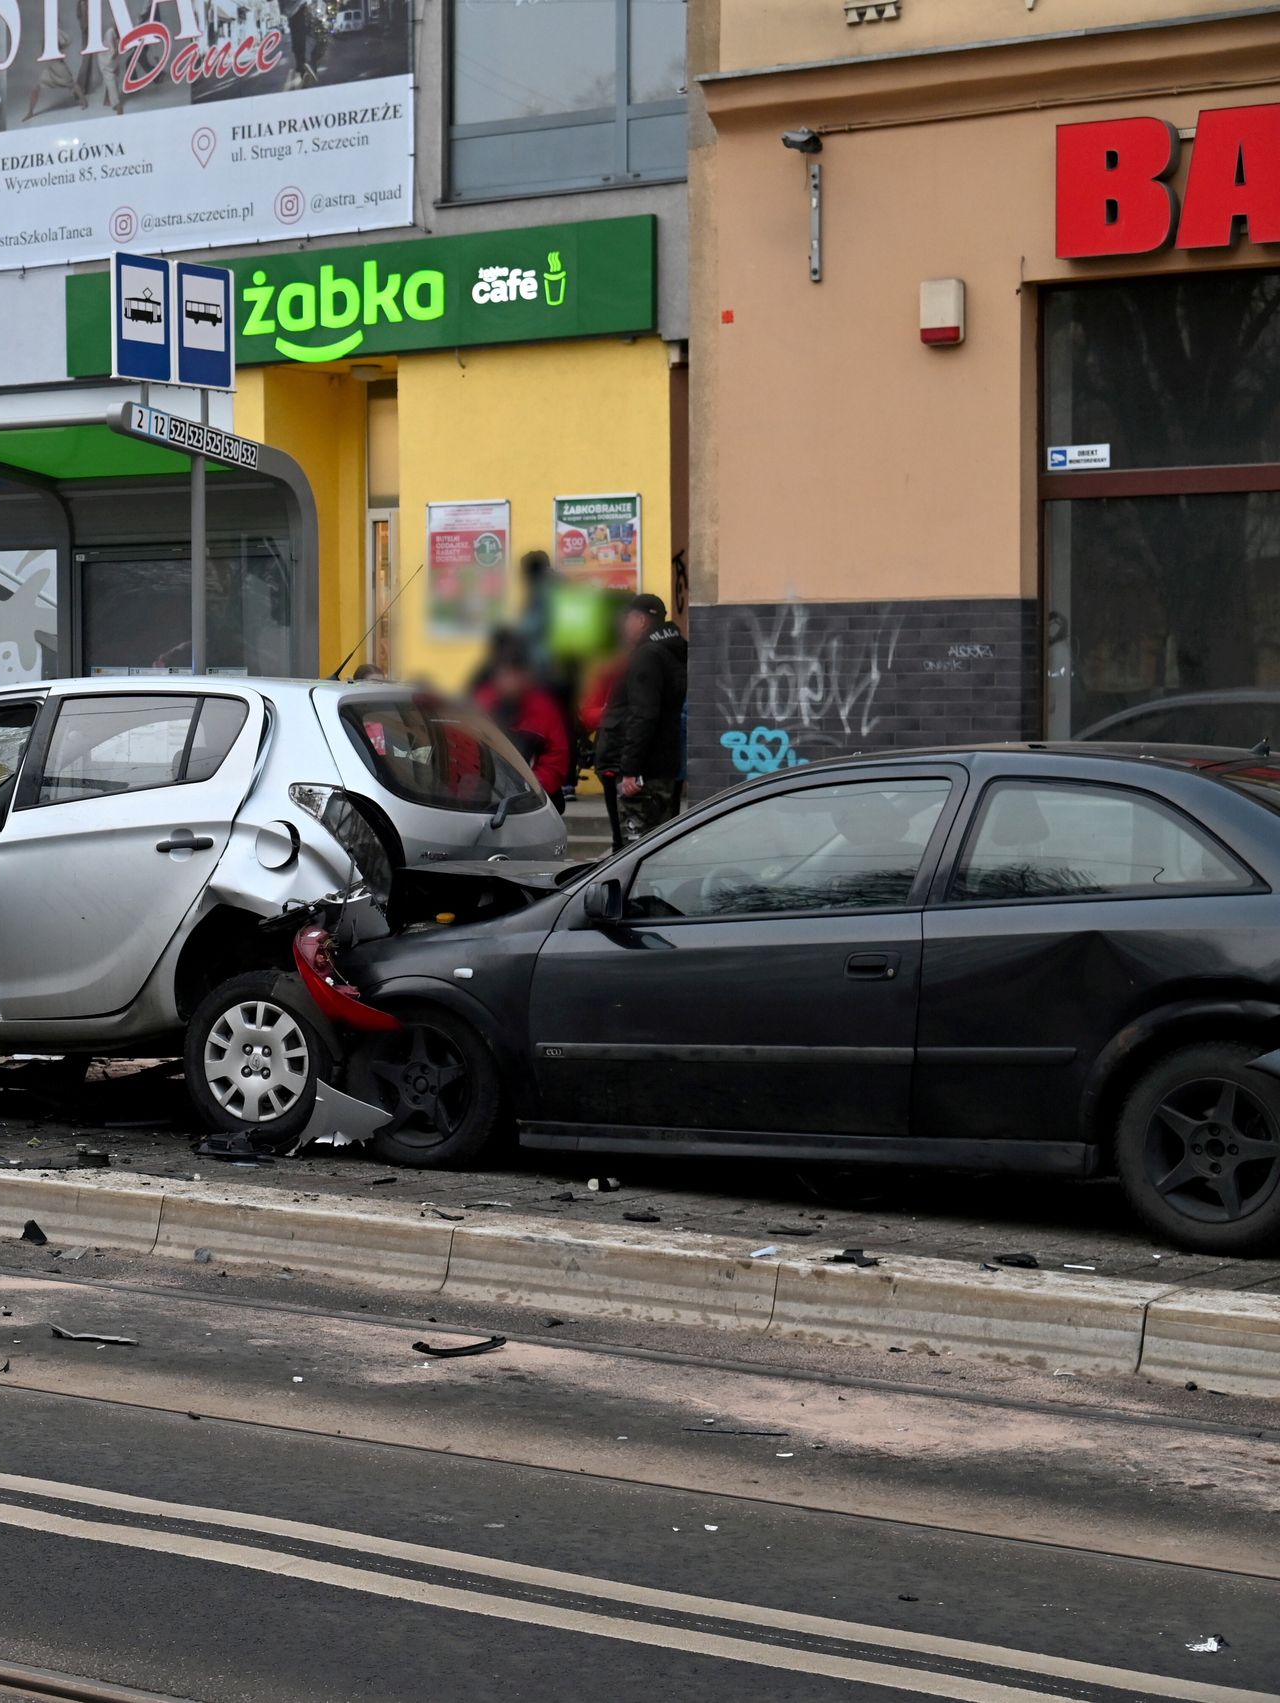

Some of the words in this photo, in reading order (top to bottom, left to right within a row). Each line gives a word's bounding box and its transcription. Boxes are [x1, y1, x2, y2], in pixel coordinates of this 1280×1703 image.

[120, 22, 282, 94] Dance
[231, 123, 273, 141] FILIA
[277, 102, 403, 135] PRAWOBRZEŻE
[58, 143, 125, 165] GŁÓWNA
[231, 148, 247, 162] ul.
[251, 143, 292, 161] Struga
[296, 139, 308, 155] 7,
[312, 131, 369, 153] Szczecin
[4, 168, 75, 194] Wyzwolenia
[79, 167, 97, 182] 85,
[100, 160, 153, 179] Szczecin
[310, 184, 402, 214] @astra_squad
[141, 202, 254, 232] @astra.szczecin.pl
[242, 260, 445, 336] żabka
[137, 410, 144, 429] 2
[154, 415, 165, 436] 12
[170, 420, 186, 443] 522
[188, 426, 204, 449] 523
[205, 431, 221, 454] 525
[223, 436, 239, 460] 530
[241, 442, 257, 466] 532
[562, 502, 633, 516] ŻABKOBRANIE
